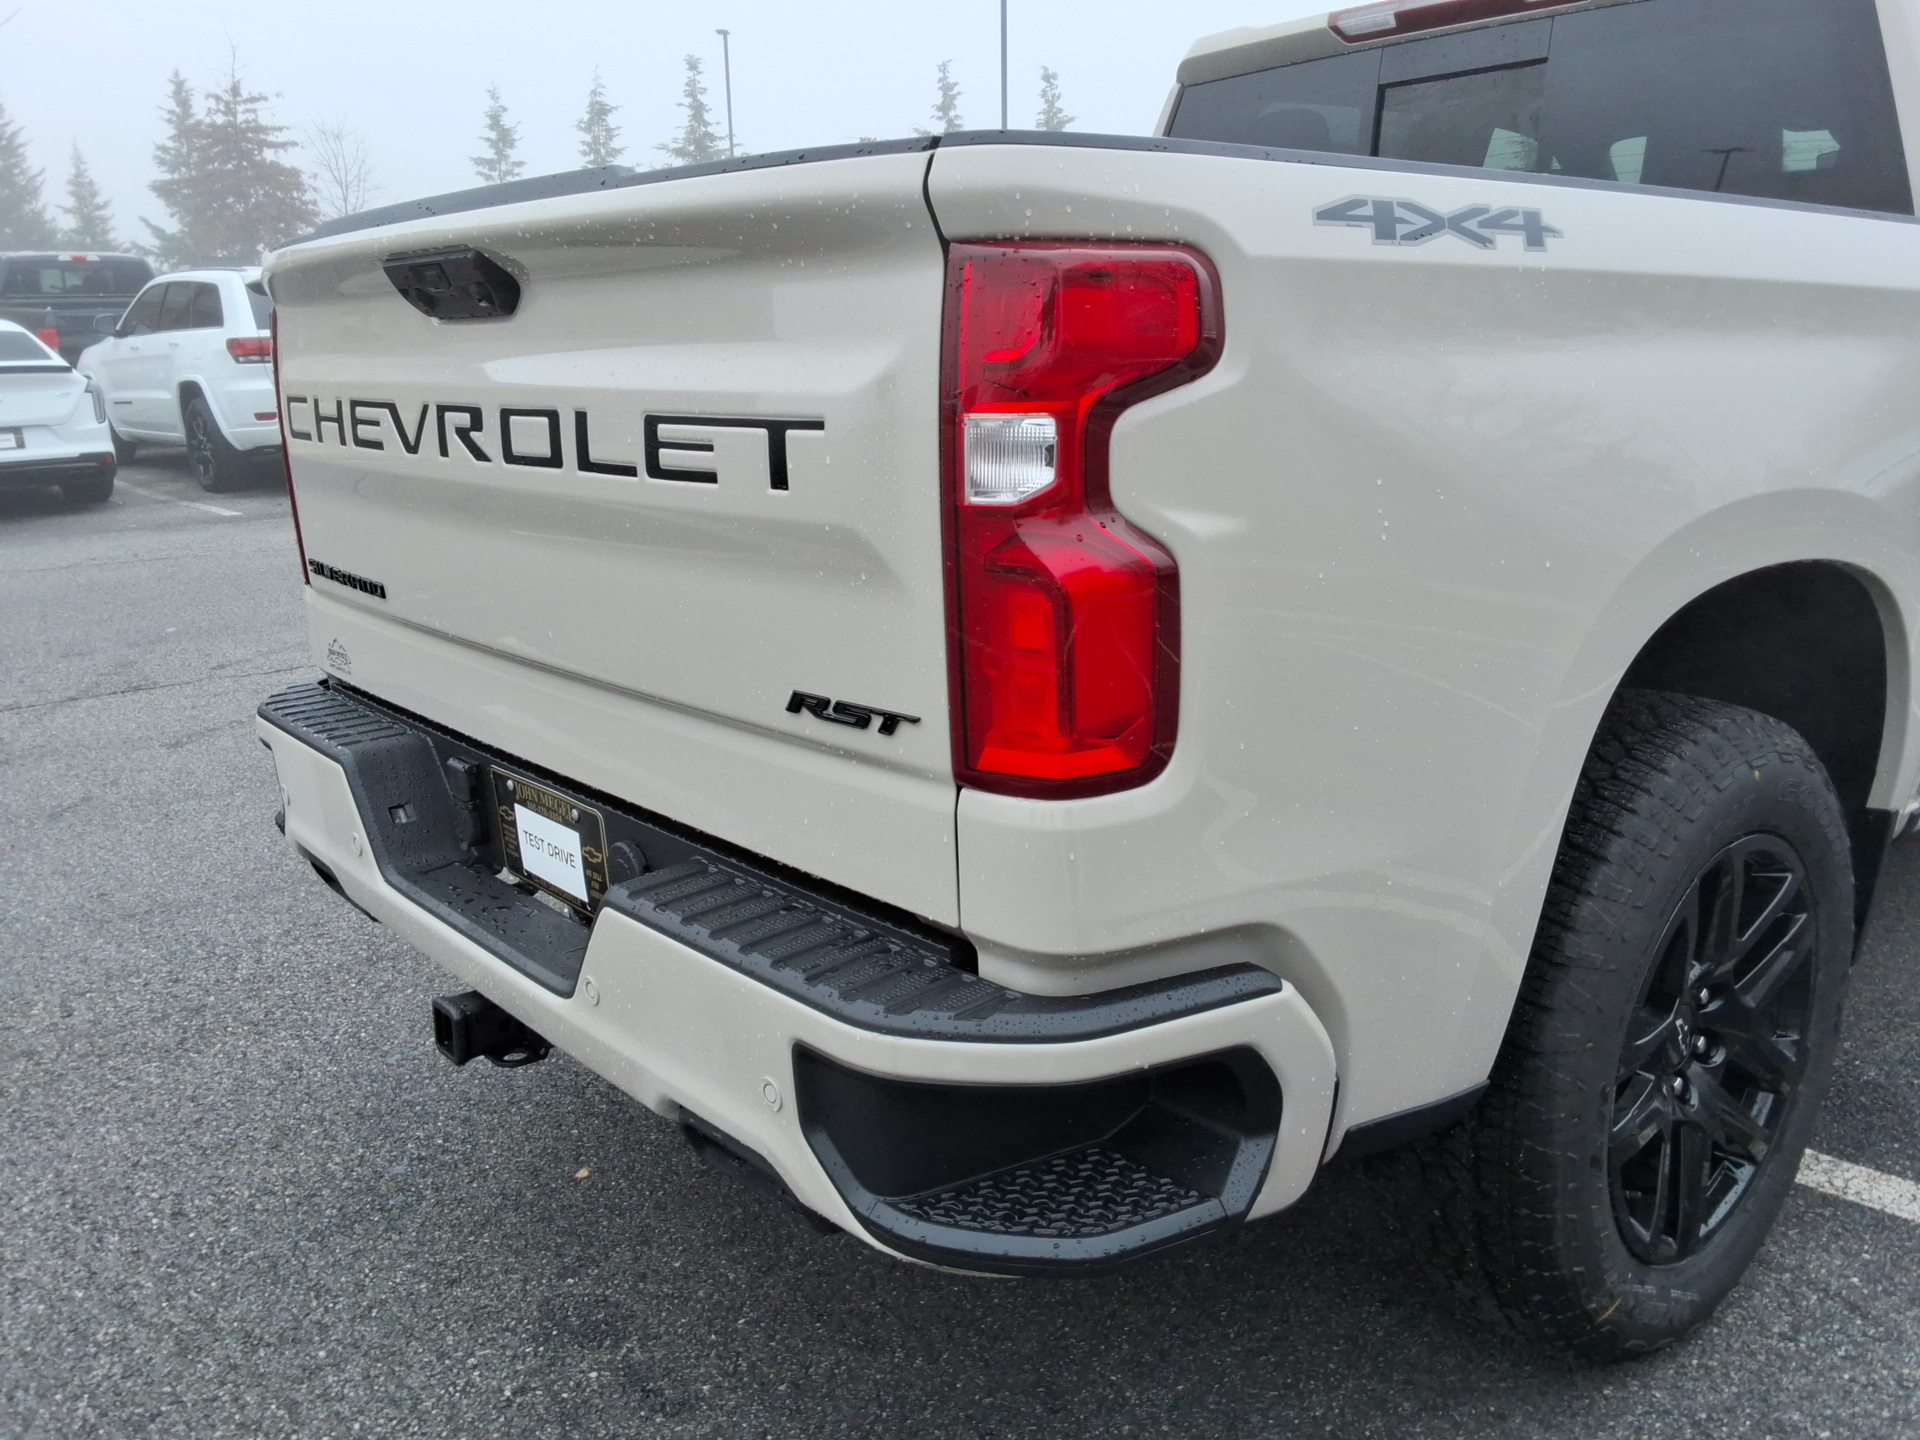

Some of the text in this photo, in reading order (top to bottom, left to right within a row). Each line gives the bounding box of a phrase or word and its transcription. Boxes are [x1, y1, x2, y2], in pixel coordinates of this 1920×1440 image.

[286, 396, 825, 491] CHEVROLET
[785, 689, 921, 736] RST
[514, 782, 576, 824] JOHN MEGEL
[523, 829, 545, 853] TEST
[547, 842, 576, 869] DRIVE
